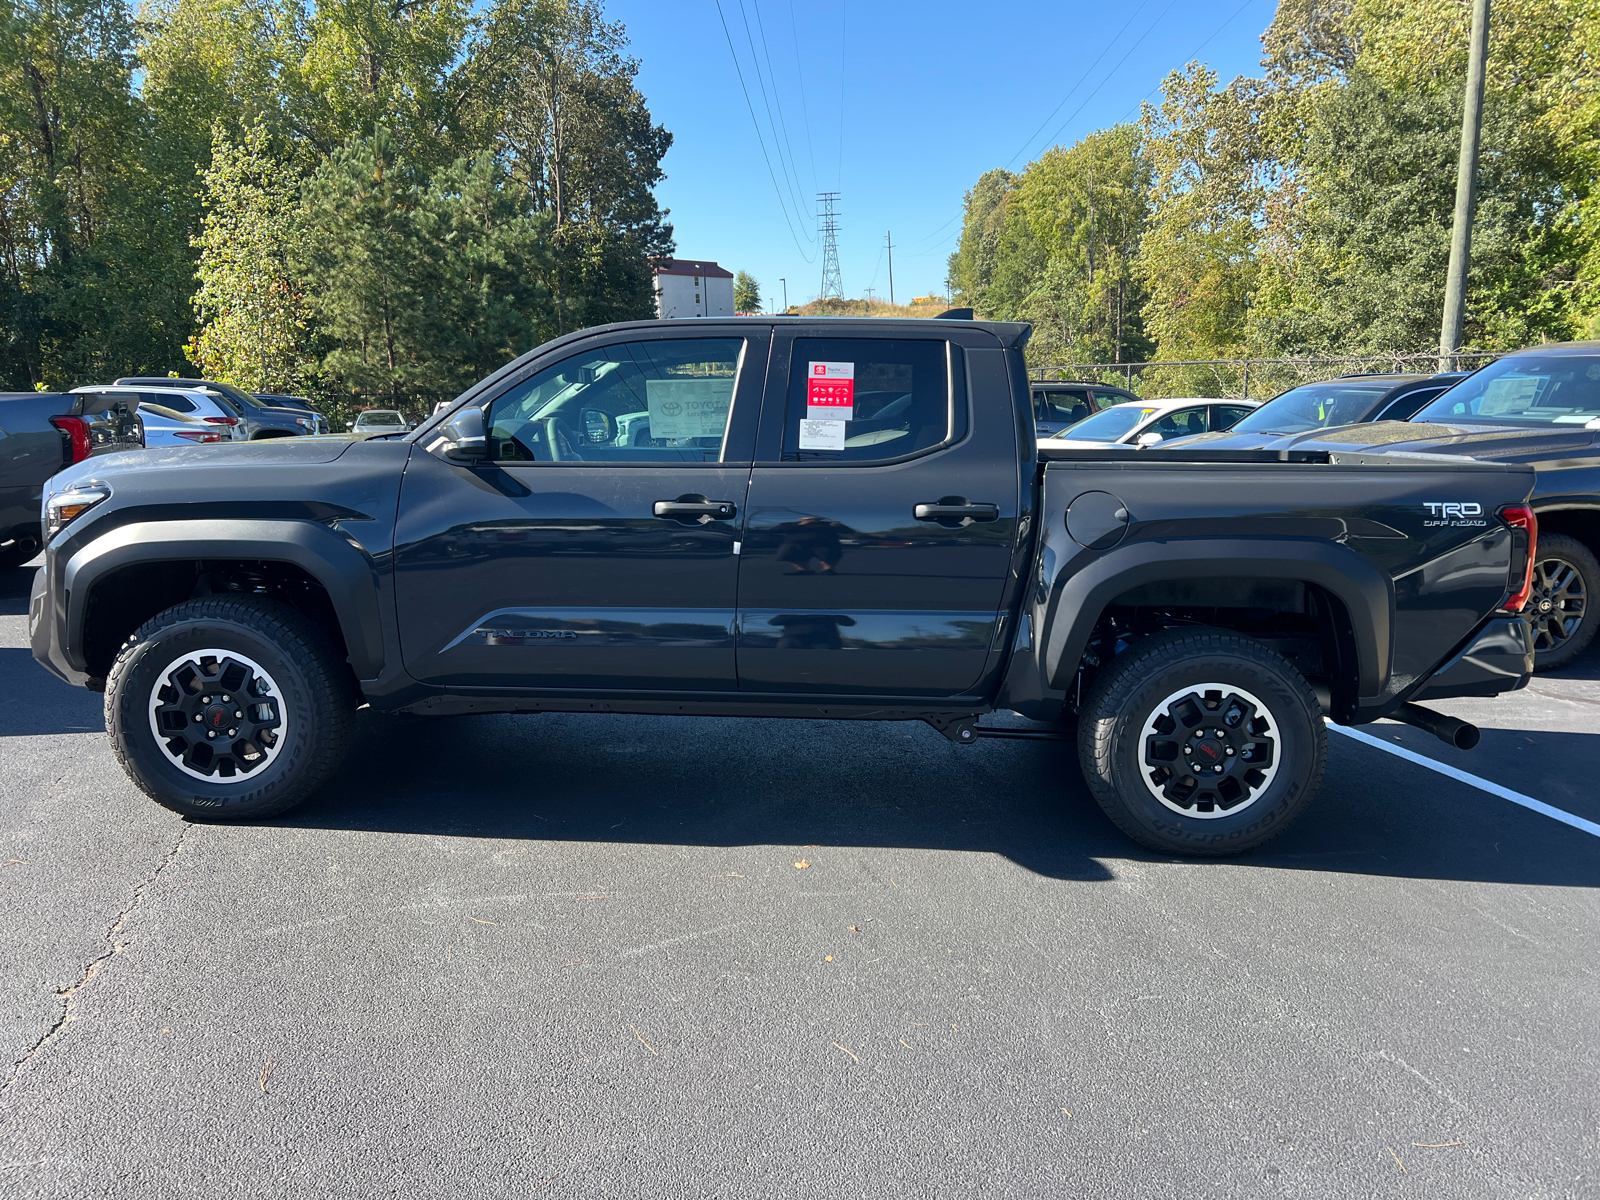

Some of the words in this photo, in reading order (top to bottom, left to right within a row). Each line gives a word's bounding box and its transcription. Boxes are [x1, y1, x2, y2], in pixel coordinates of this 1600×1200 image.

[684, 401, 727, 409] TOYOTA
[1423, 502, 1483, 518] TRD
[476, 629, 578, 639] TACOMA
[1151, 779, 1301, 845] BFGoodrich
